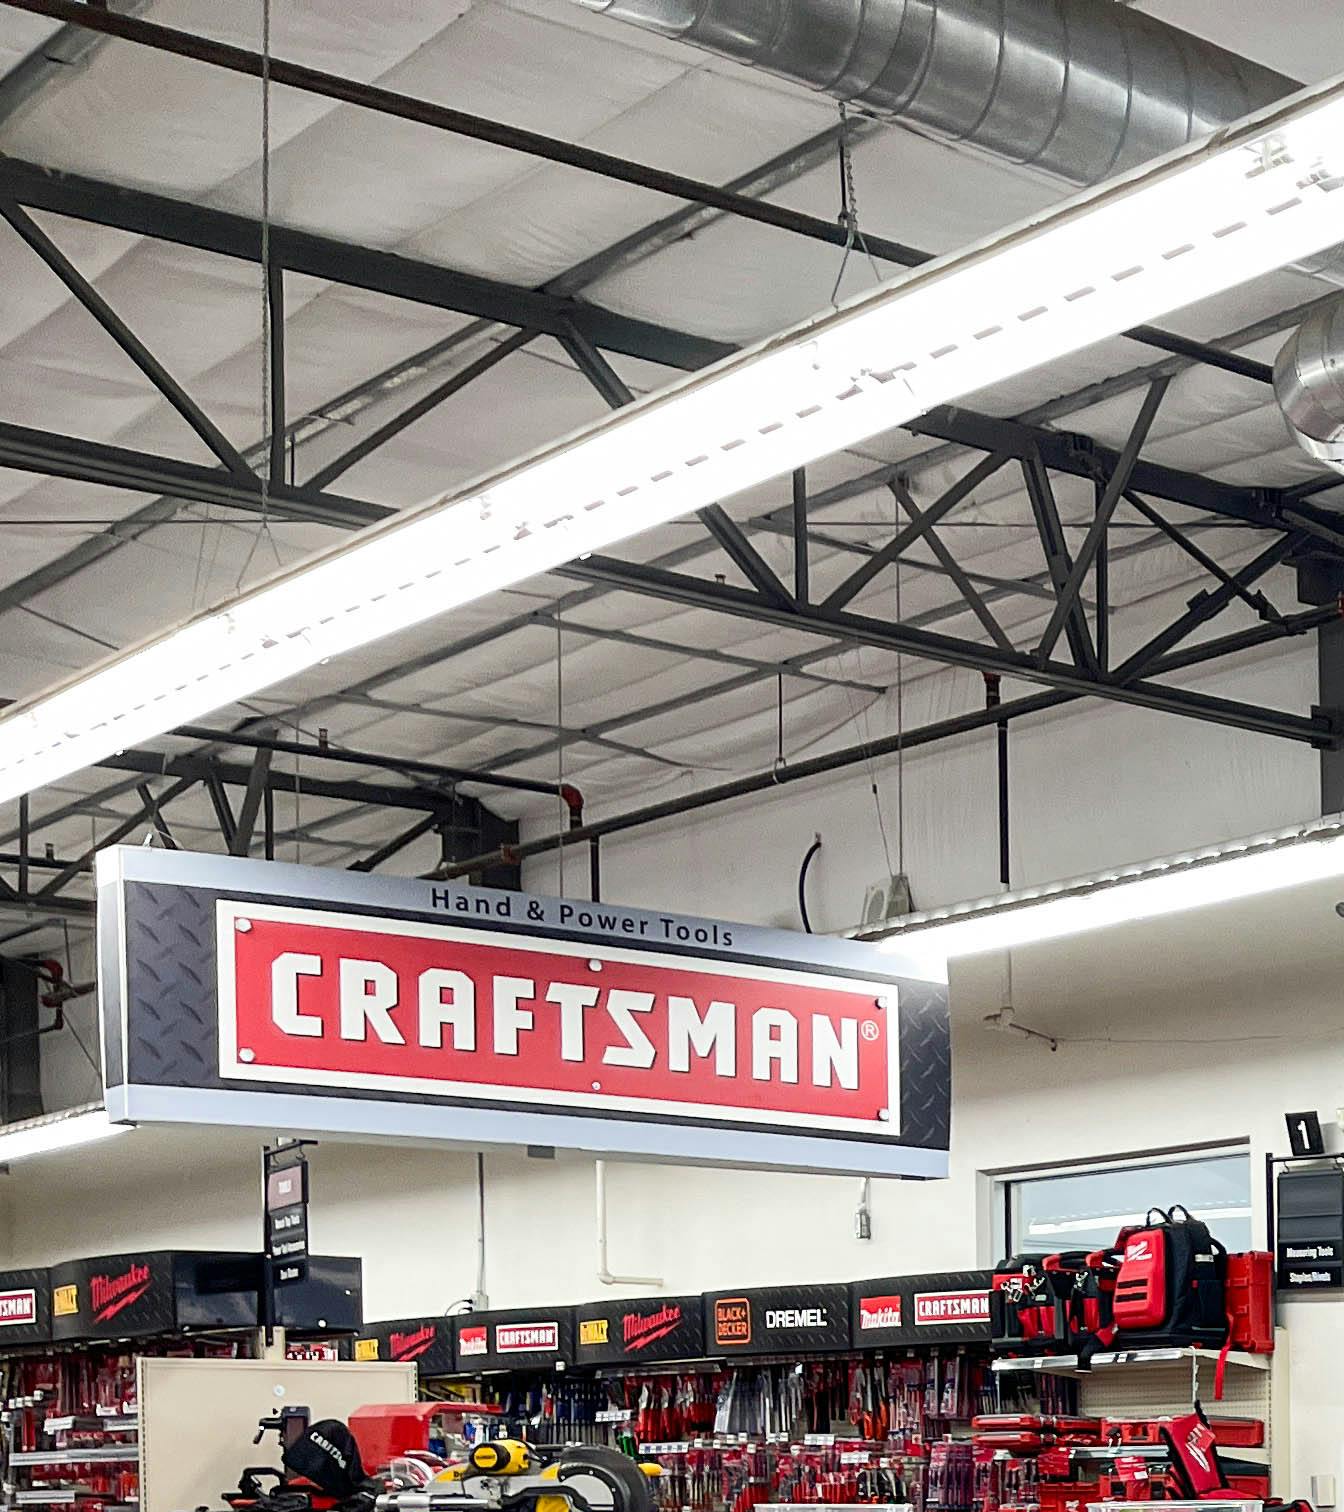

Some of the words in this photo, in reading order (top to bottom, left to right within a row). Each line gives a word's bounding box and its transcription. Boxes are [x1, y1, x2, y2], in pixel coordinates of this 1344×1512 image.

[431, 888, 512, 917] Hand
[526, 900, 545, 922] &
[560, 904, 648, 934] Power
[660, 918, 734, 946] Tools
[271, 951, 861, 1091] CRAFTSMAN
[1297, 1120, 1310, 1150] 1
[766, 1307, 825, 1329] DREMEL
[918, 1296, 990, 1317] CRAFTSMAN
[623, 1303, 682, 1343] Milwaukee
[718, 1322, 748, 1337] DECKER
[498, 1328, 557, 1349] CRAFTSMAN
